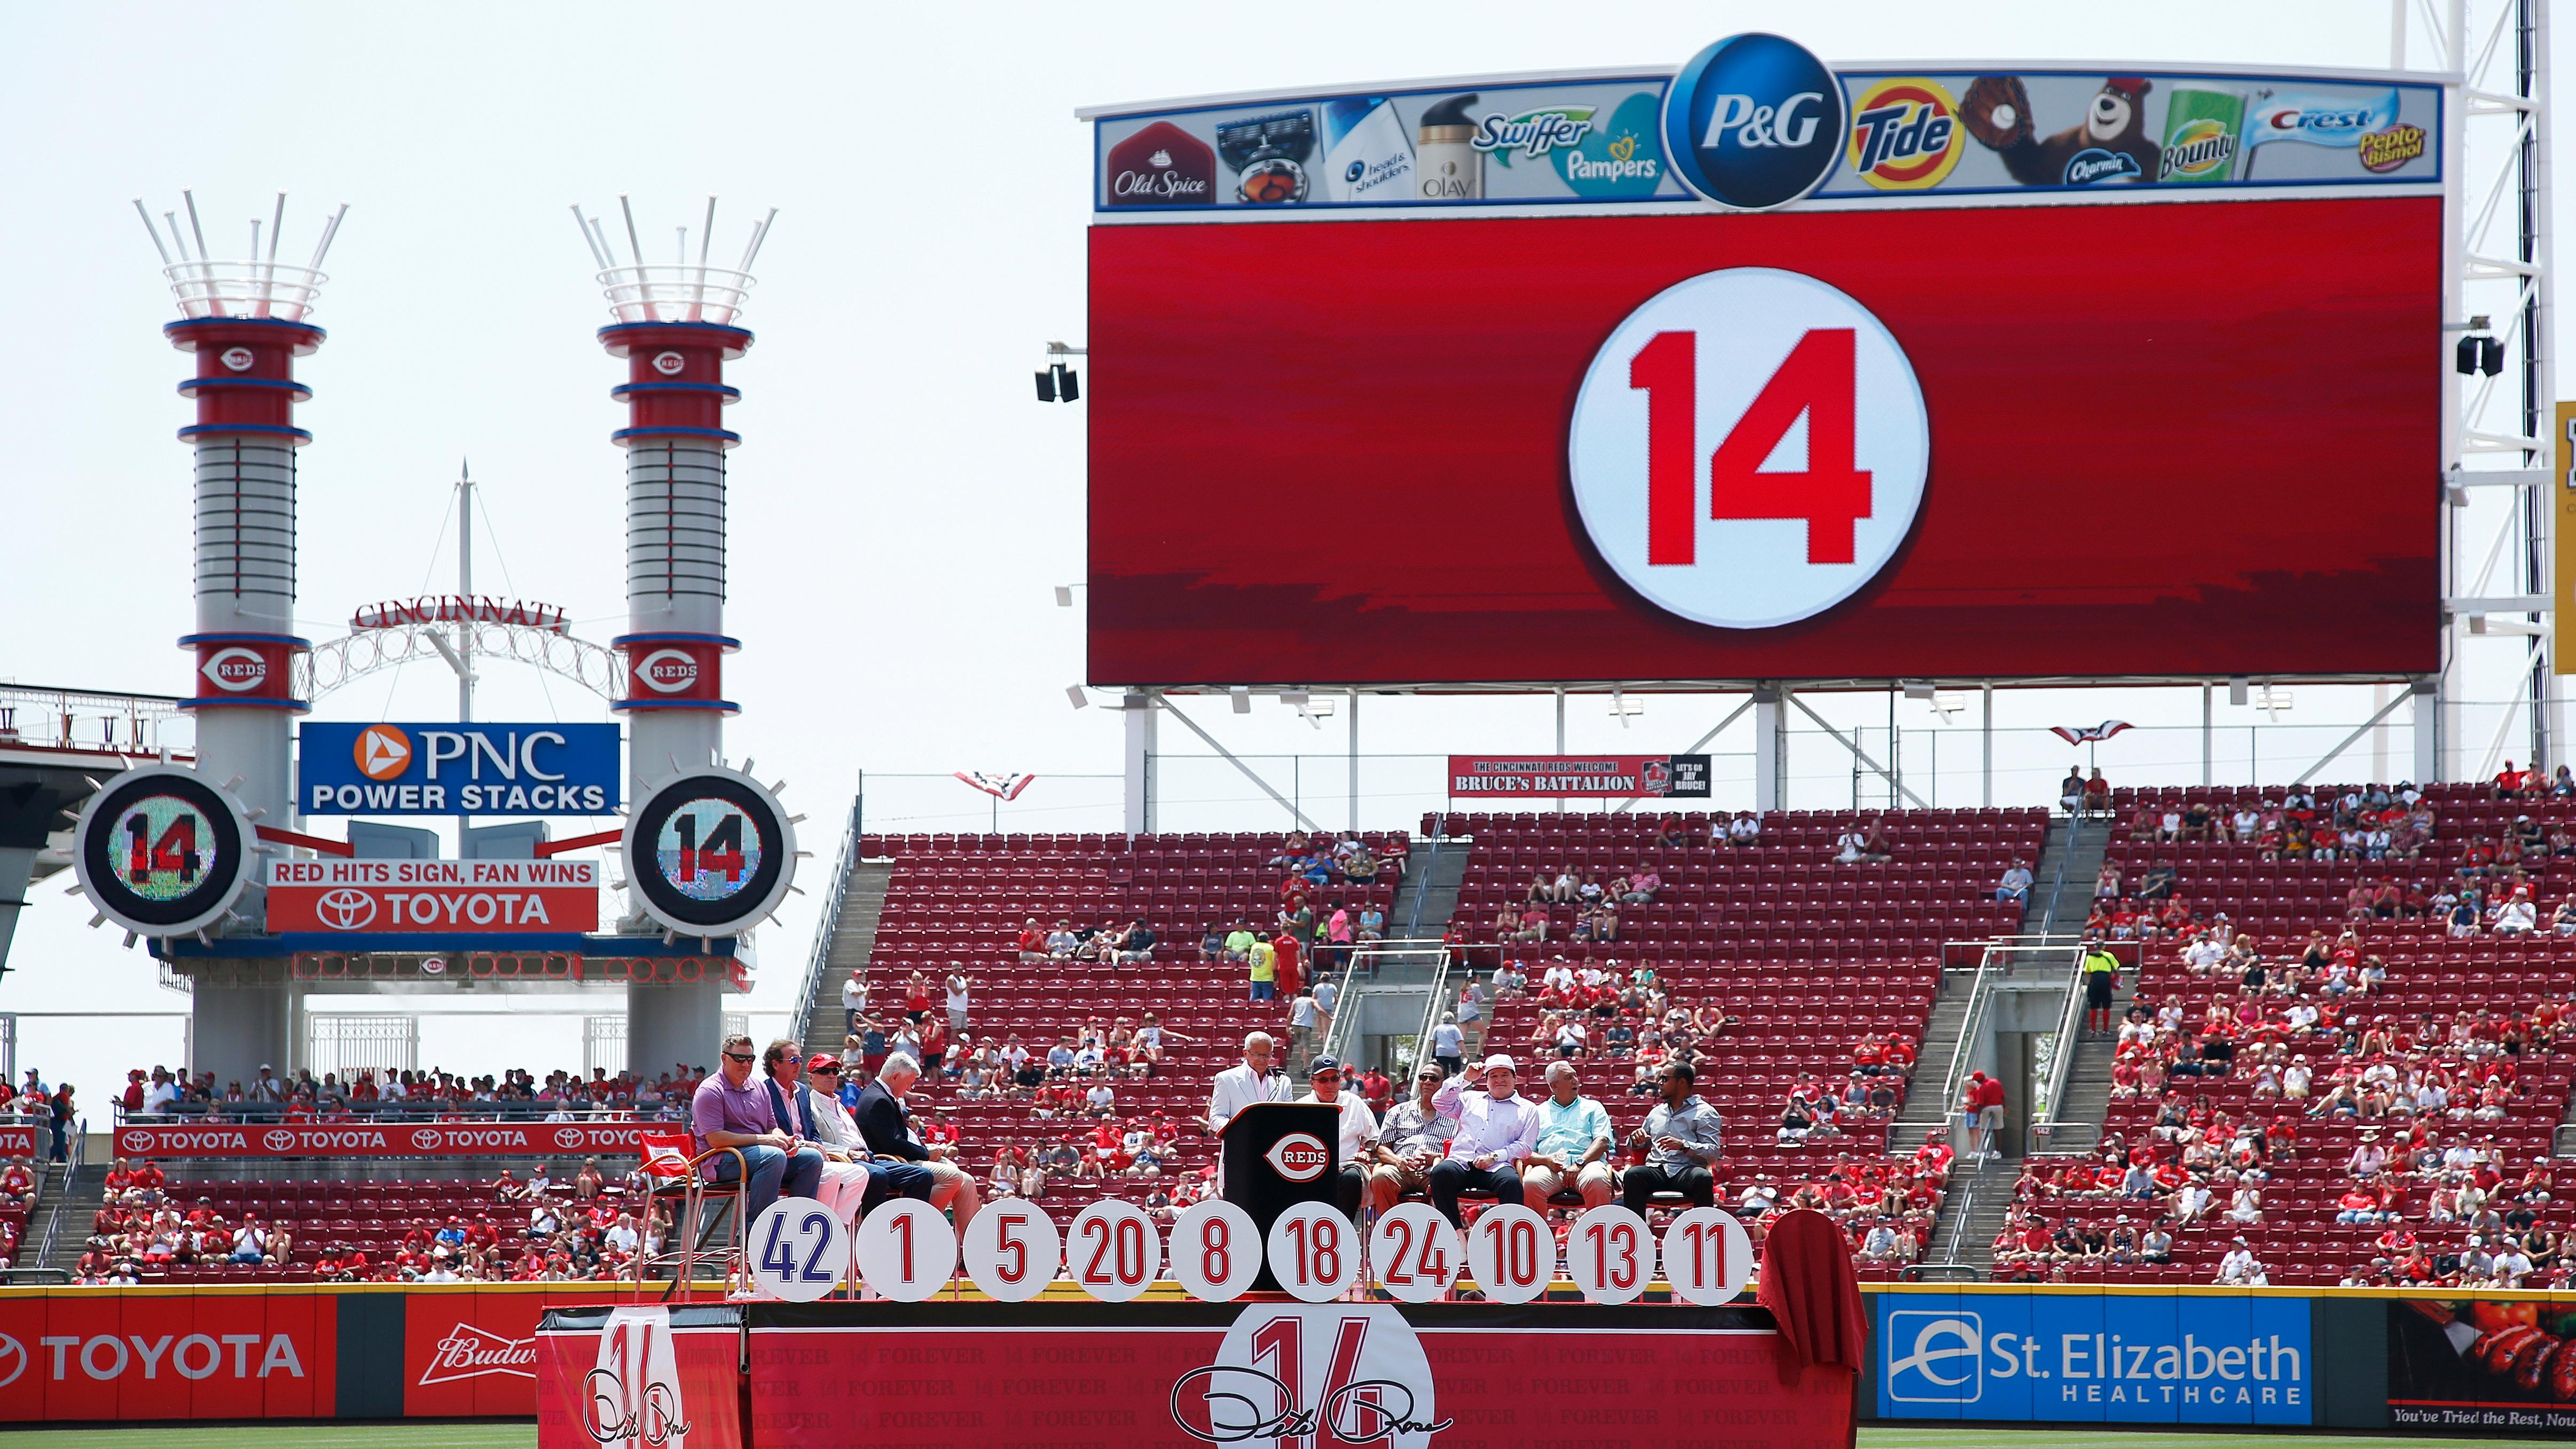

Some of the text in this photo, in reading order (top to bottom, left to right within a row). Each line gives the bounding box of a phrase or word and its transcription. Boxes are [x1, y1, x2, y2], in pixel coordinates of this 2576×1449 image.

[1701, 92, 1824, 148] P&G
[2271, 108, 2371, 130] Crest
[1472, 112, 1591, 156] Swiffer
[1855, 103, 1953, 175] Tide
[1369, 154, 1397, 176] head
[1567, 150, 1656, 182] Pampers
[2070, 154, 2124, 183] Charmin
[2159, 131, 2236, 182] Bounty
[2367, 142, 2423, 167] Bismol
[1114, 170, 1206, 199] Old Spice
[1356, 163, 1409, 193] shoulders
[1630, 328, 1872, 565] 14
[355, 593, 567, 632] CINCINNATI
[219, 664, 266, 677] REDS
[652, 665, 697, 678] REDS
[418, 731, 566, 781] PNC
[1474, 762, 1619, 772] THE CINCINNATI REDS WELCOME
[1676, 763, 1703, 772] LET'S GO
[1534, 776, 1636, 792] BATTALION
[1675, 780, 1706, 790] BRUCE!
[1683, 772, 1697, 781] JAY
[312, 784, 604, 810] POWER STACKS
[125, 813, 201, 884] 14
[674, 813, 745, 882] 14
[274, 863, 592, 886] RED HITS SIGN, FAN WINS
[384, 892, 549, 925] TOYOTA
[0, 1133, 31, 1149] TA
[159, 1132, 248, 1149] TOYOTA
[299, 1131, 387, 1149] TOYOTA
[445, 1130, 529, 1147] TOYOTA
[1284, 1151, 1326, 1163] REDS
[759, 1211, 833, 1283] 42
[890, 1213, 915, 1283] 1
[995, 1213, 1028, 1285] 5
[1081, 1215, 1146, 1287] 20
[1200, 1216, 1232, 1287] 8
[1284, 1217, 1342, 1287] 18
[1383, 1217, 1450, 1288] 24
[1484, 1218, 1539, 1288] 10
[1585, 1221, 1639, 1291] 13
[1683, 1221, 1727, 1290] 11
[40, 1333, 305, 1381] TOYOTA
[877, 1347, 986, 1365] FOREVER
[1031, 1347, 1137, 1364] FOREVER
[1557, 1348, 1659, 1364] FOREVER
[1990, 1332, 2302, 1382] St. Elizabeth
[847, 1379, 957, 1397] FOREVER
[1002, 1379, 1108, 1395] FOREVER
[1251, 1315, 1395, 1449] 14
[1530, 1378, 1632, 1395] FOREVER
[1674, 1380, 1771, 1395] FOREVER
[2062, 1384, 2302, 1405] HEALTHCARE
[879, 1411, 986, 1428] FOREVER
[1033, 1409, 1137, 1427] FOREVER
[1560, 1409, 1661, 1425] FOREVER
[1702, 1409, 1800, 1425] FOREVER
[2394, 1409, 2439, 1423] You've
[2442, 1410, 2479, 1424] Tried
[2483, 1412, 2506, 1425] the
[2509, 1412, 2543, 1429] Rest,
